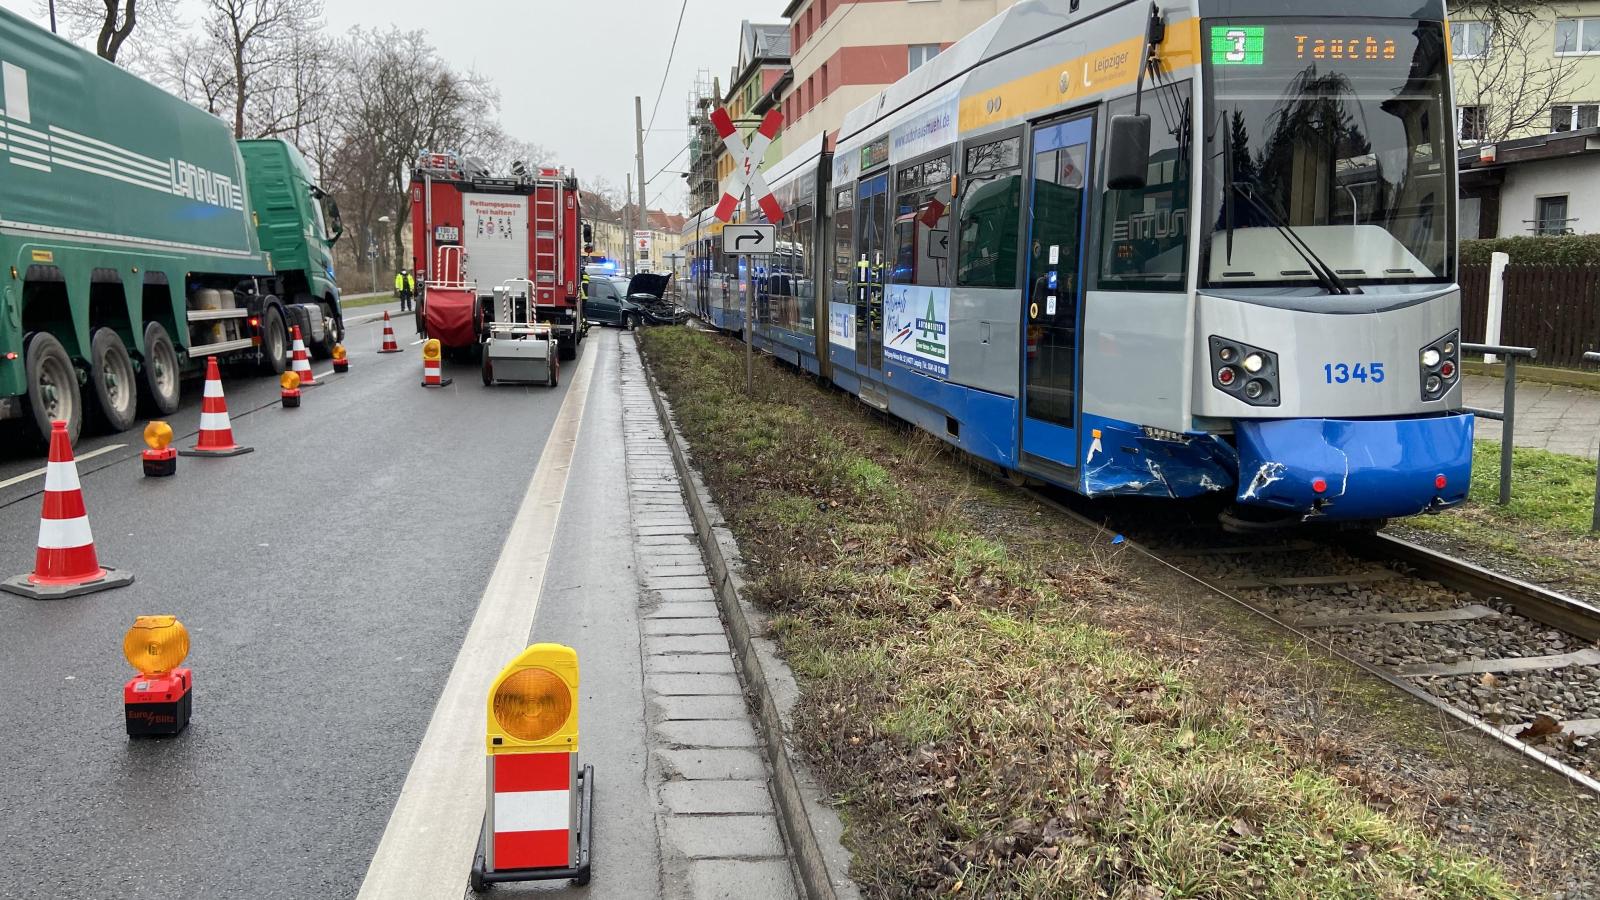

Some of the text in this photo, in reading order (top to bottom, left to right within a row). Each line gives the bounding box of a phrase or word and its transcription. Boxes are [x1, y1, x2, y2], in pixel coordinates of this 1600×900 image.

[1225, 29, 1396, 62] 3 Taucha
[1094, 51, 1129, 72] Leipziger
[1324, 362, 1385, 384] 1345
[128, 710, 176, 724] Euro Blitz
